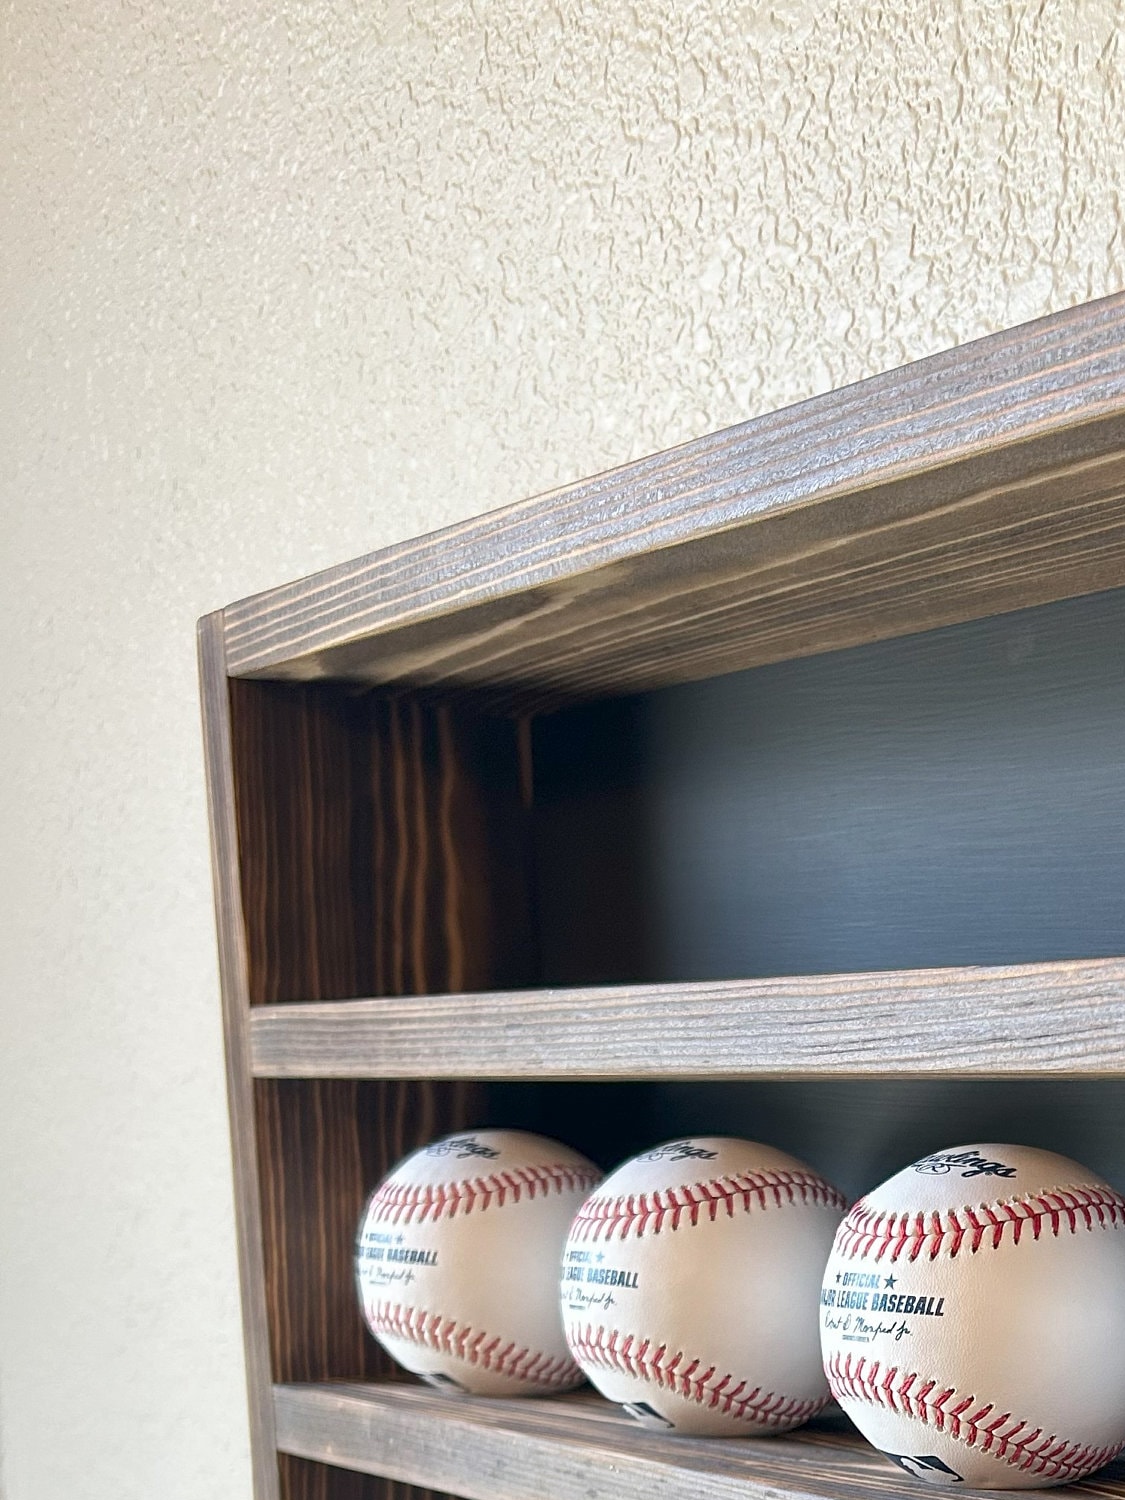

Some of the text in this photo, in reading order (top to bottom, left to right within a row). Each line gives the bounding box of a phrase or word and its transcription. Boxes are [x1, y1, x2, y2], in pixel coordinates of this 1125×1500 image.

[387, 1249, 438, 1266] BASEBALL
[587, 1268, 639, 1288] BASEBALL
[842, 1272, 881, 1289] OFFICIAL
[837, 1290, 871, 1311] LEAGUE
[871, 1293, 945, 1317] BASEBALL
